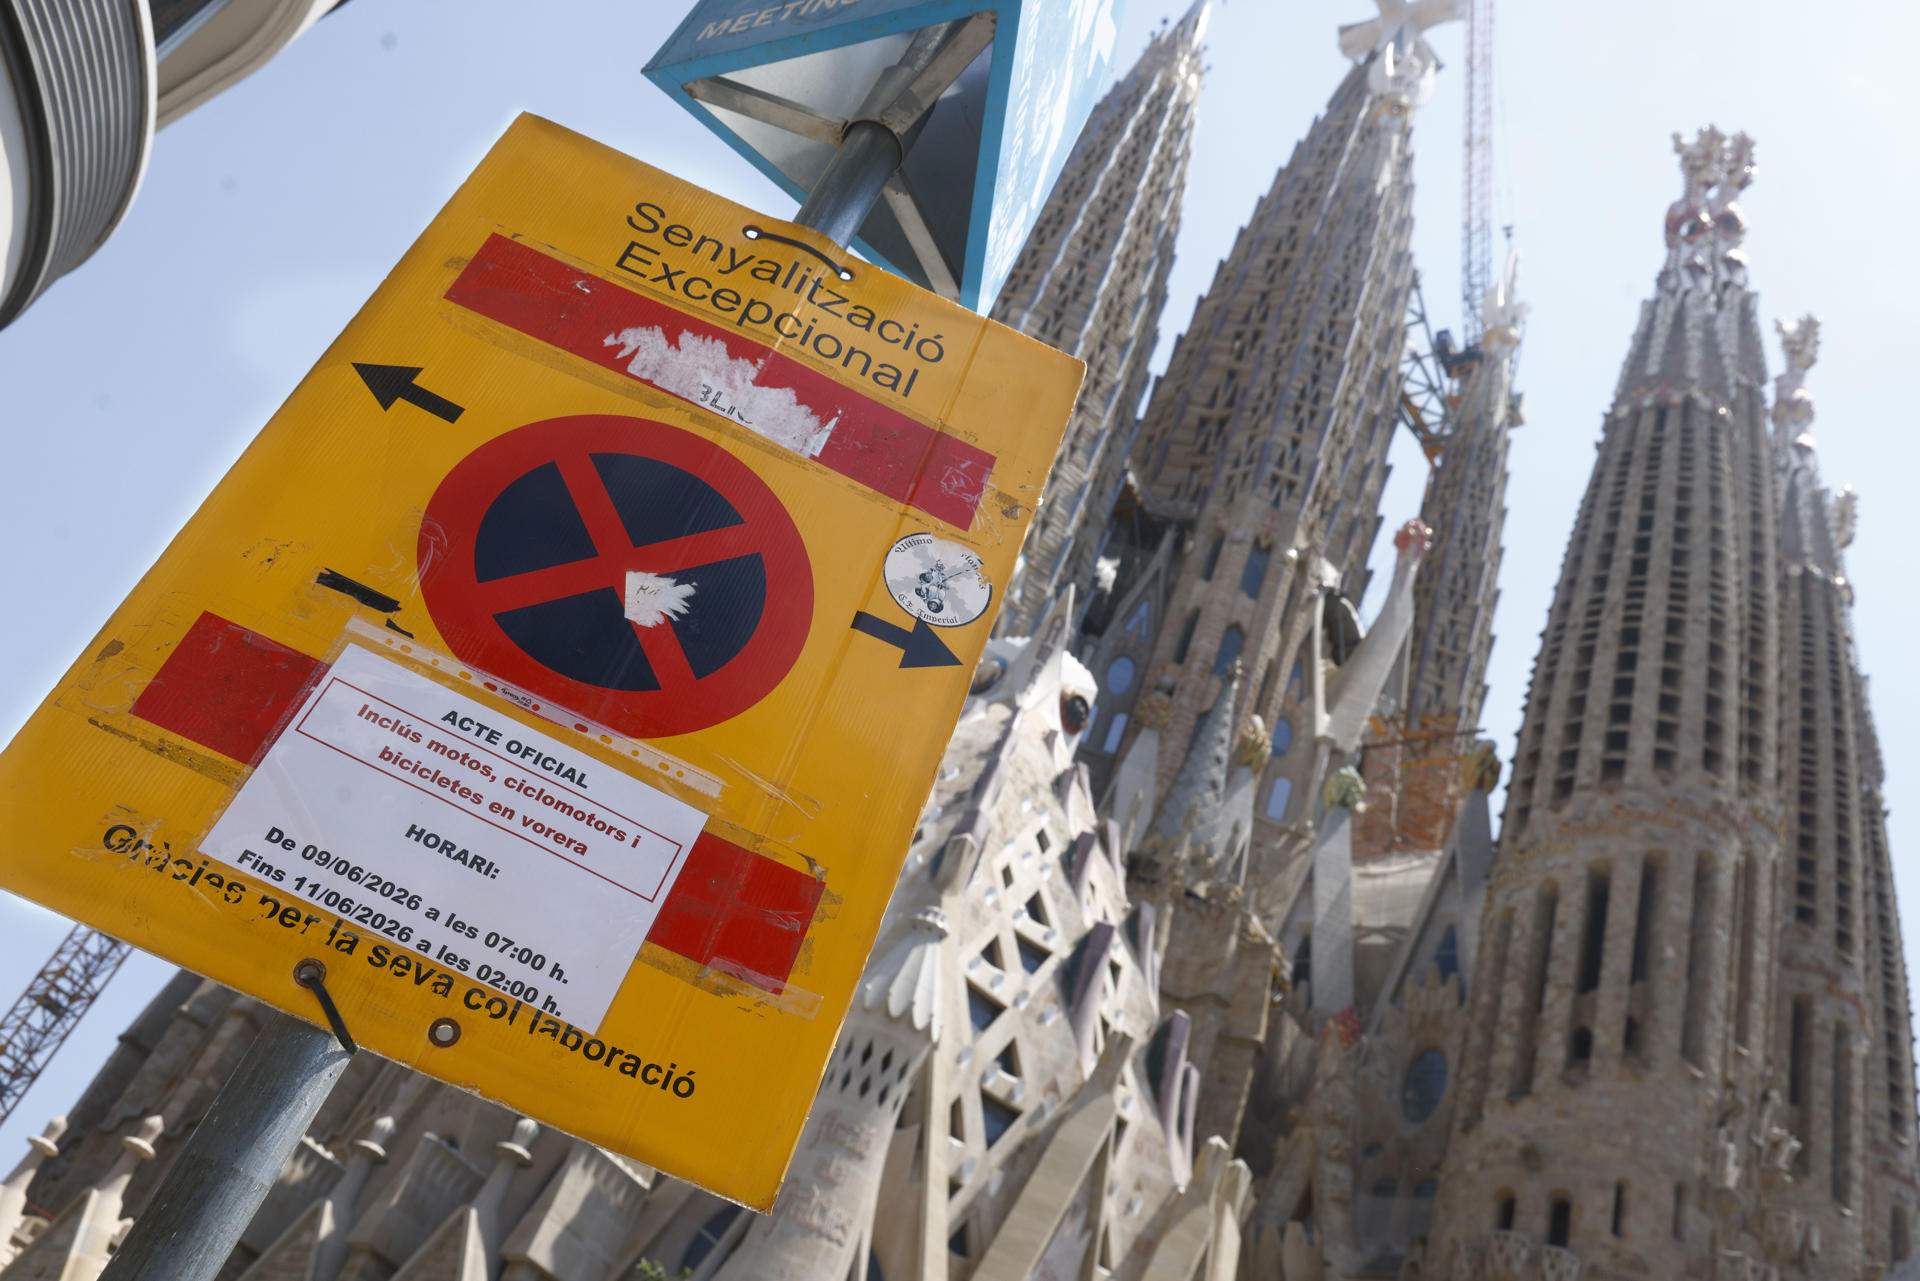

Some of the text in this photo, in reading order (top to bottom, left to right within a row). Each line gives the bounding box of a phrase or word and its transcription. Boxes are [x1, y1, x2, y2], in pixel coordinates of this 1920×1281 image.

[695, 0, 864, 41] MEETIN
[615, 240, 919, 397] Excepcional
[626, 202, 945, 363] Senyalització
[356, 703, 642, 849] Inclús motos, ciclomotors i
[378, 745, 589, 857] bicicletes en vorera
[441, 710, 589, 789] ACTE OFICIAL
[264, 826, 569, 984] De 09/06/2026 a les 07:00 h.
[404, 823, 500, 881] HORARI:
[236, 849, 562, 1017] Fins 11/06/2026 a les 02:00 h.
[324, 918, 361, 956] la
[367, 945, 455, 999] seva
